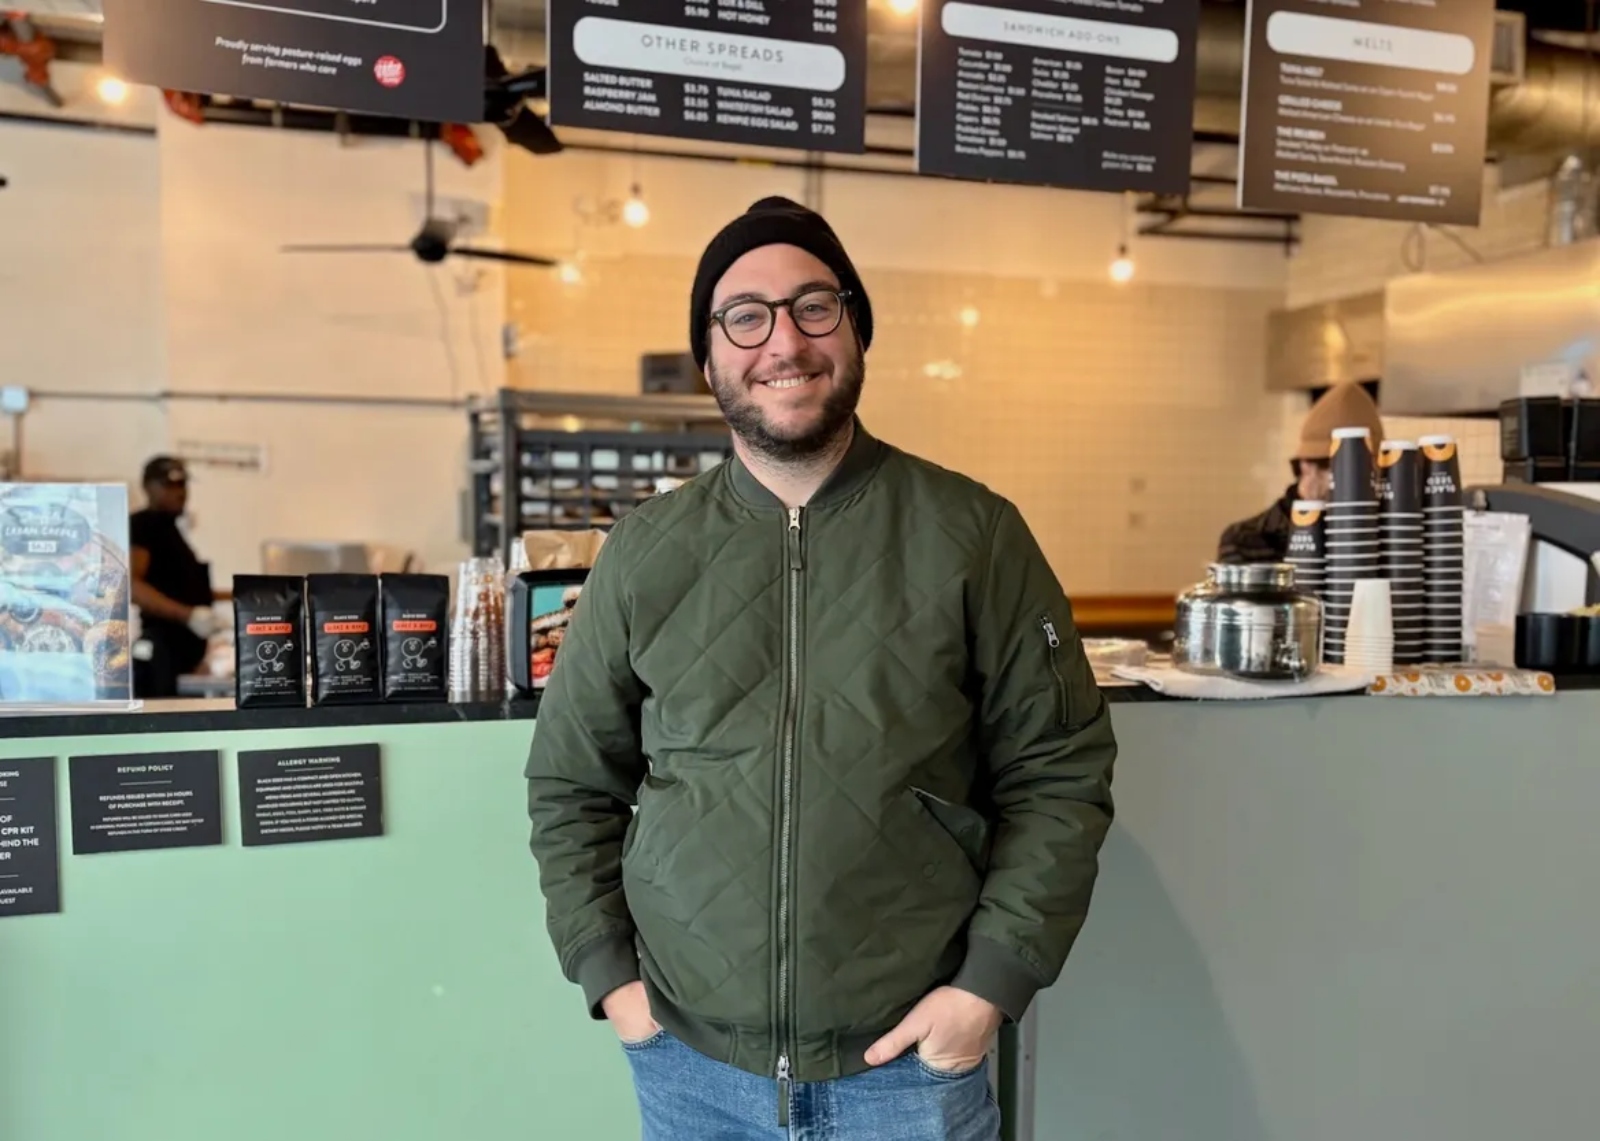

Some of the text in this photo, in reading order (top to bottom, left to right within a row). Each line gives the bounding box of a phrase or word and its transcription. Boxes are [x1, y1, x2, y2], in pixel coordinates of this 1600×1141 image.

[717, 10, 771, 26] HOT HONEY
[1003, 21, 1066, 37] SANDWICH
[215, 36, 362, 67] Proudly serving pasture-raised eggs
[640, 34, 784, 63] OTHER SPREADS
[241, 53, 337, 75] from farmers who care
[583, 71, 653, 89] SALTED BUTTER
[583, 85, 657, 103] RASPBERRY JAM
[716, 85, 772, 102] TUNA SALAD
[582, 99, 661, 117] ALMOND BUTTER
[716, 99, 794, 118] WHITEFISH SALAD
[715, 113, 799, 132] KEWPIE EGG SALAD
[117, 763, 174, 773] REFUND POLICY
[277, 756, 341, 766] ALLERGY WARNING
[0, 814, 12, 823] OF
[1, 826, 35, 835] CPR KIT
[22, 838, 39, 846] THE
